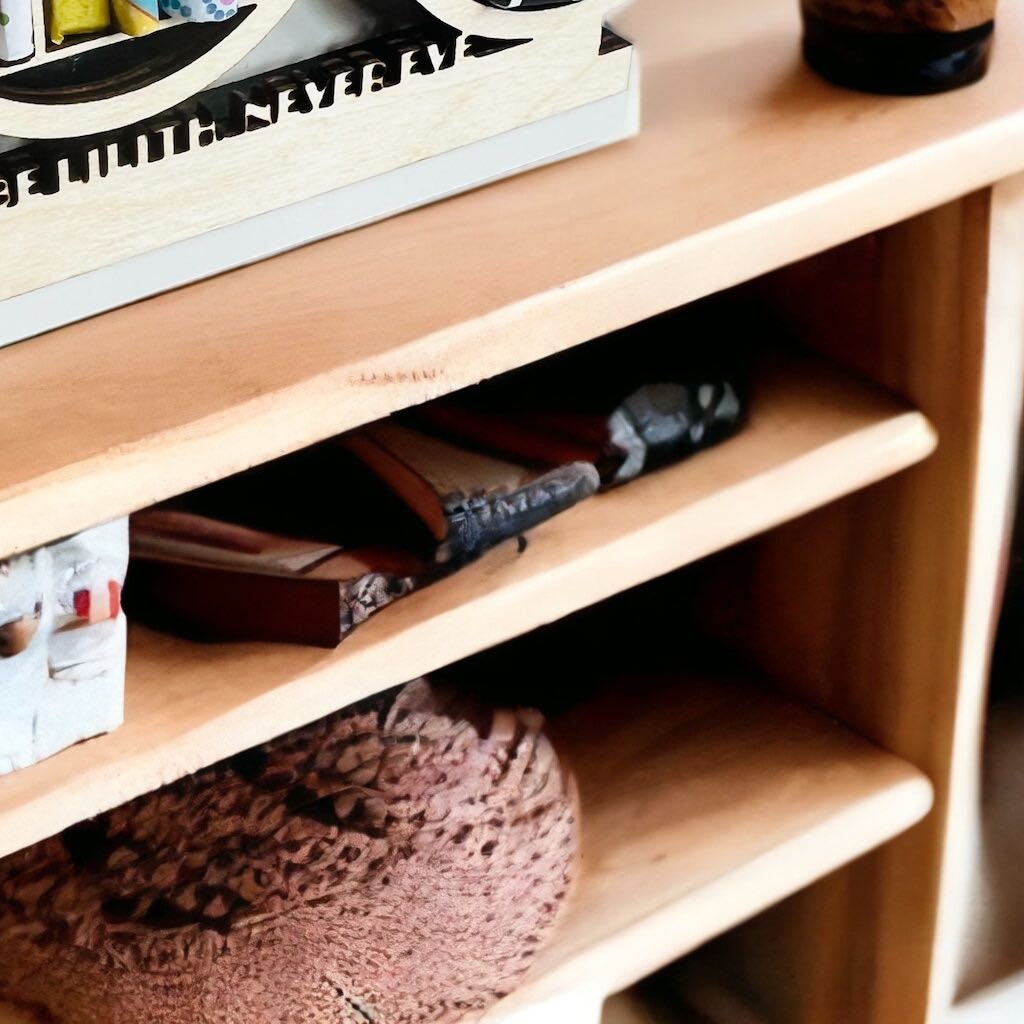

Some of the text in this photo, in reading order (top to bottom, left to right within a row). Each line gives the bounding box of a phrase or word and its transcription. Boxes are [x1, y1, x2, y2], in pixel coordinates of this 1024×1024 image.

[57, 117, 216, 193] LILITH
[244, 60, 387, 133] NEVER
[400, 32, 474, 83] EVE
